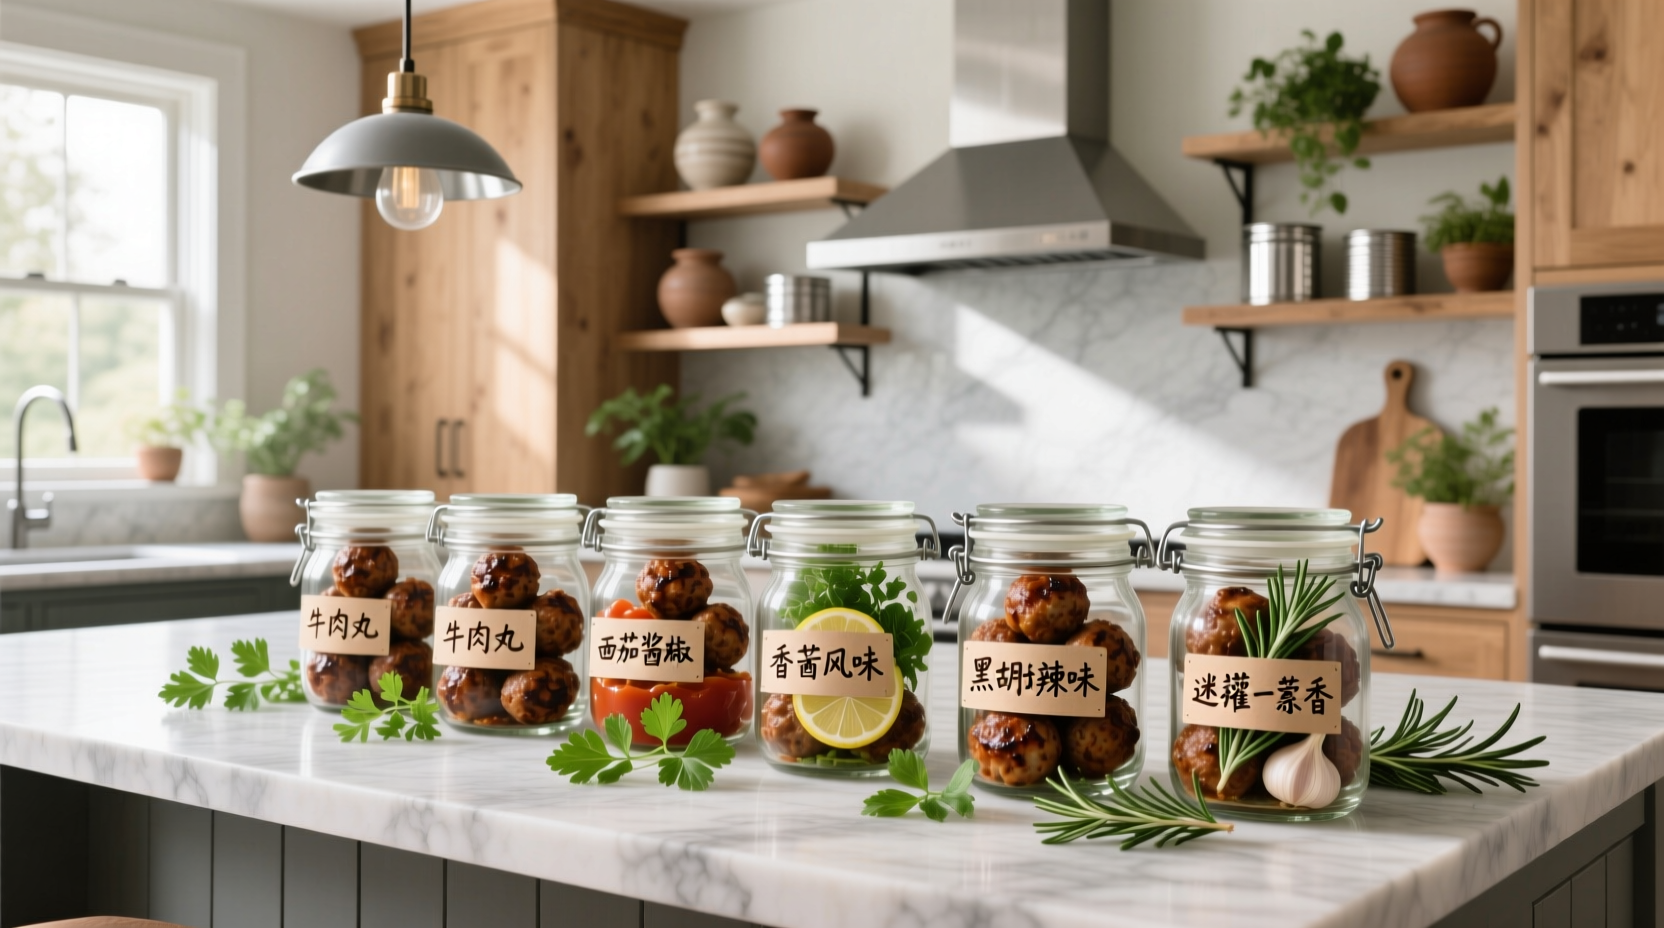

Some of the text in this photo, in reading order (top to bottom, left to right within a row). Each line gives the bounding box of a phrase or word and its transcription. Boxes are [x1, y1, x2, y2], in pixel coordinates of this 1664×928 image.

[307, 607, 379, 640] 牛肉丸
[443, 620, 525, 654] 牛肉丸
